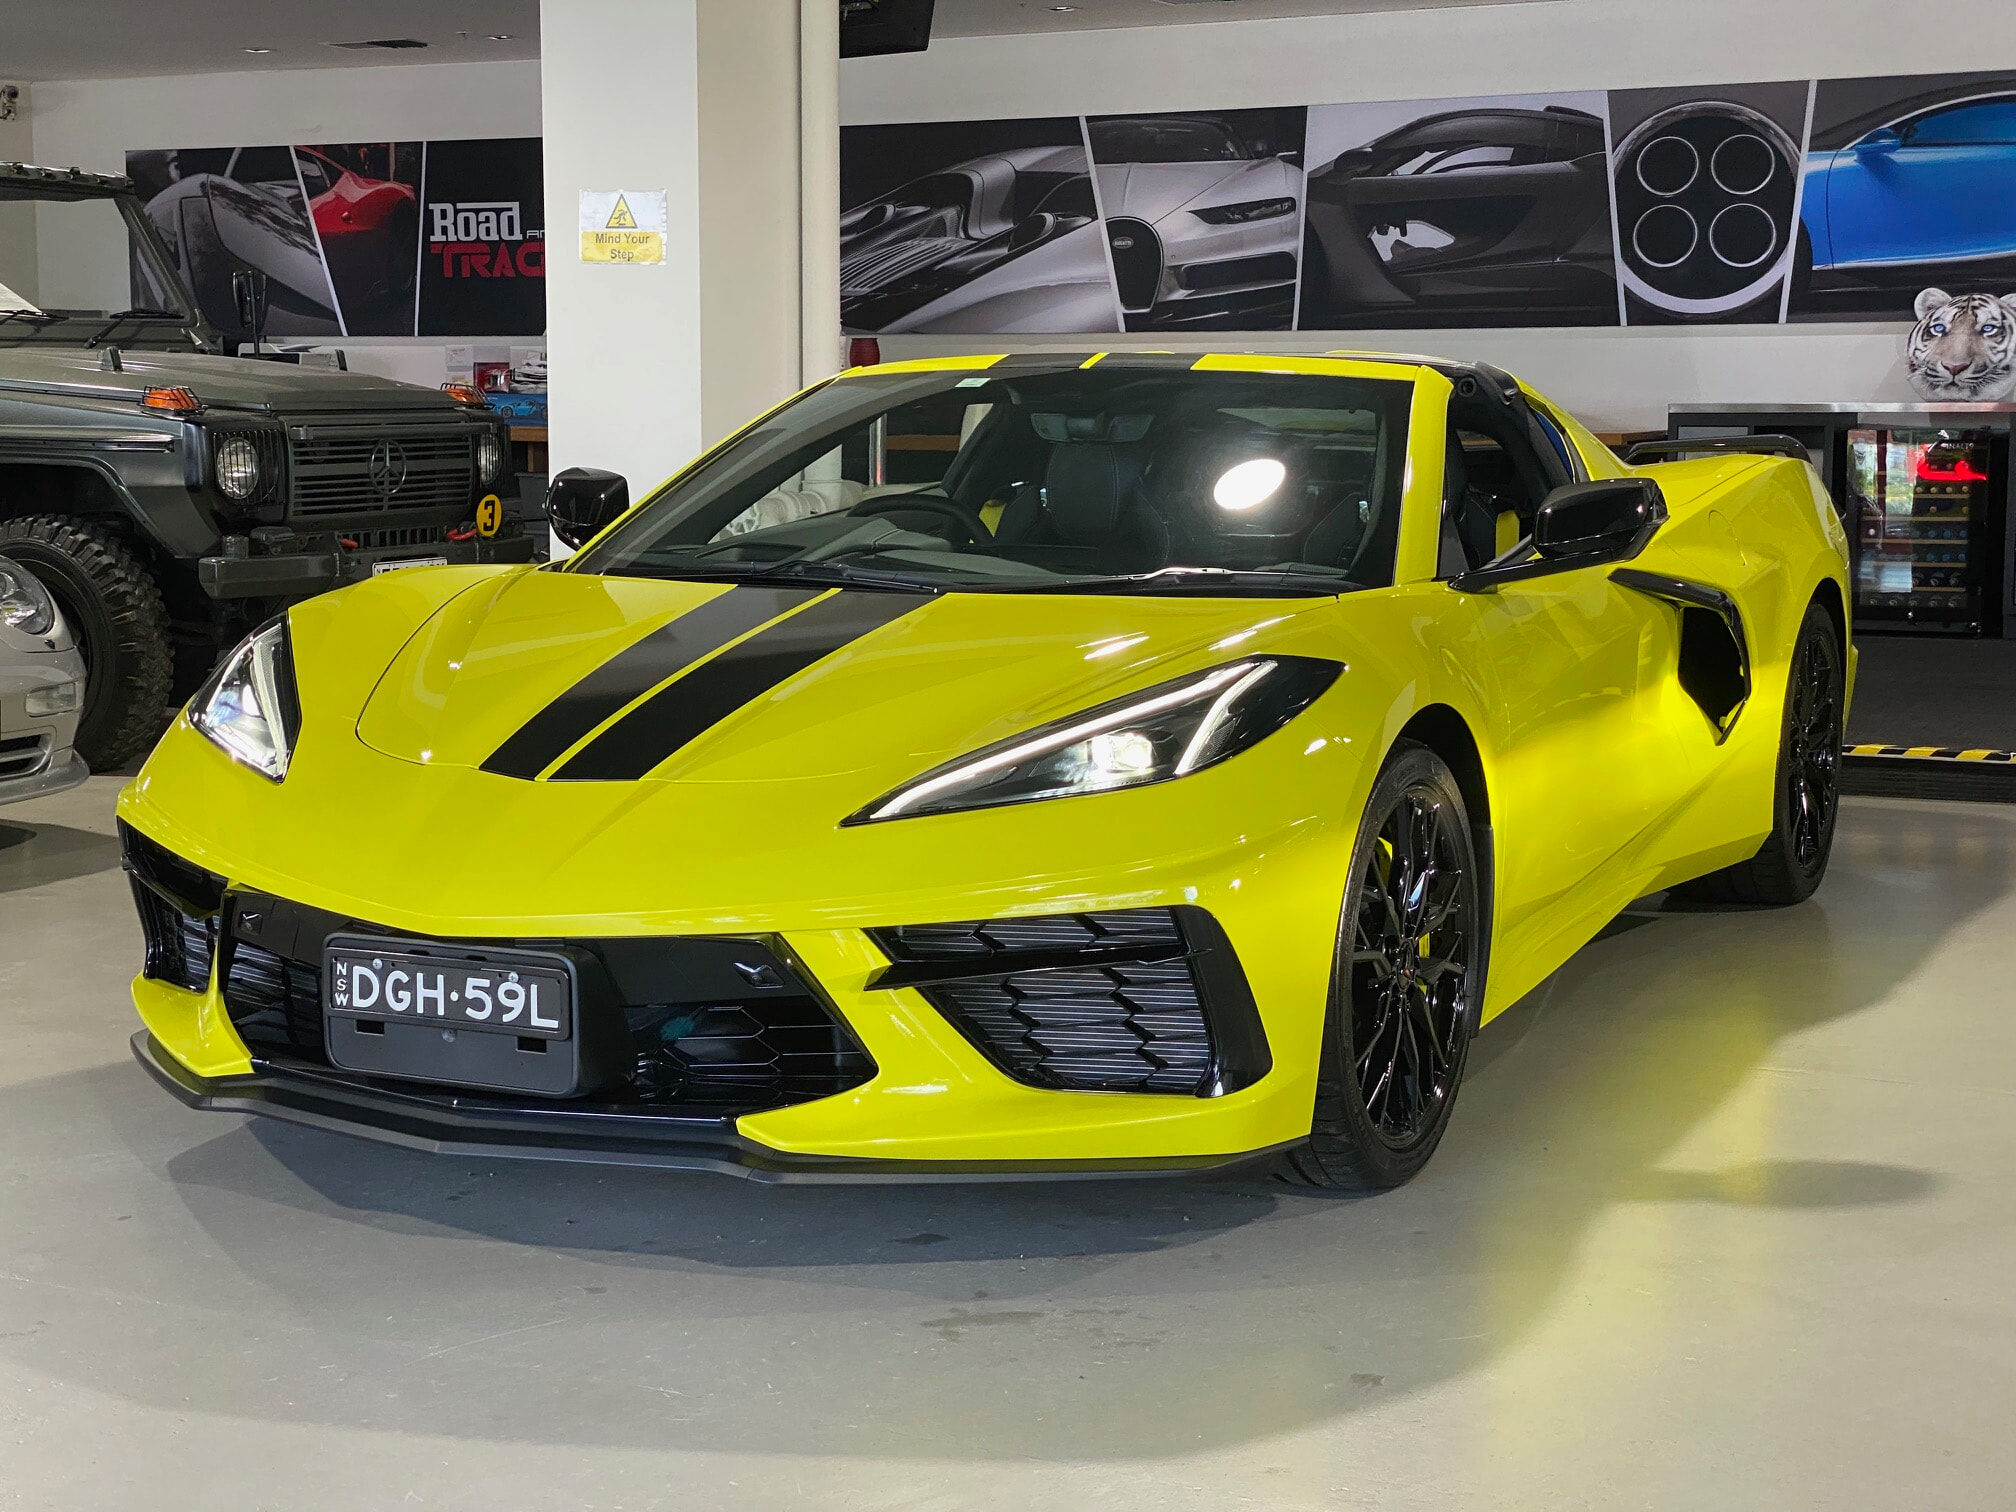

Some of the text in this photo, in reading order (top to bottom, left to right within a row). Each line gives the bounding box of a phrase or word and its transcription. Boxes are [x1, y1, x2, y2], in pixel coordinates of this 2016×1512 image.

[428, 201, 523, 241] Road
[596, 233, 650, 244] Mind Your
[430, 242, 545, 278] TRAC
[610, 249, 635, 262] Step
[483, 500, 496, 532] 3
